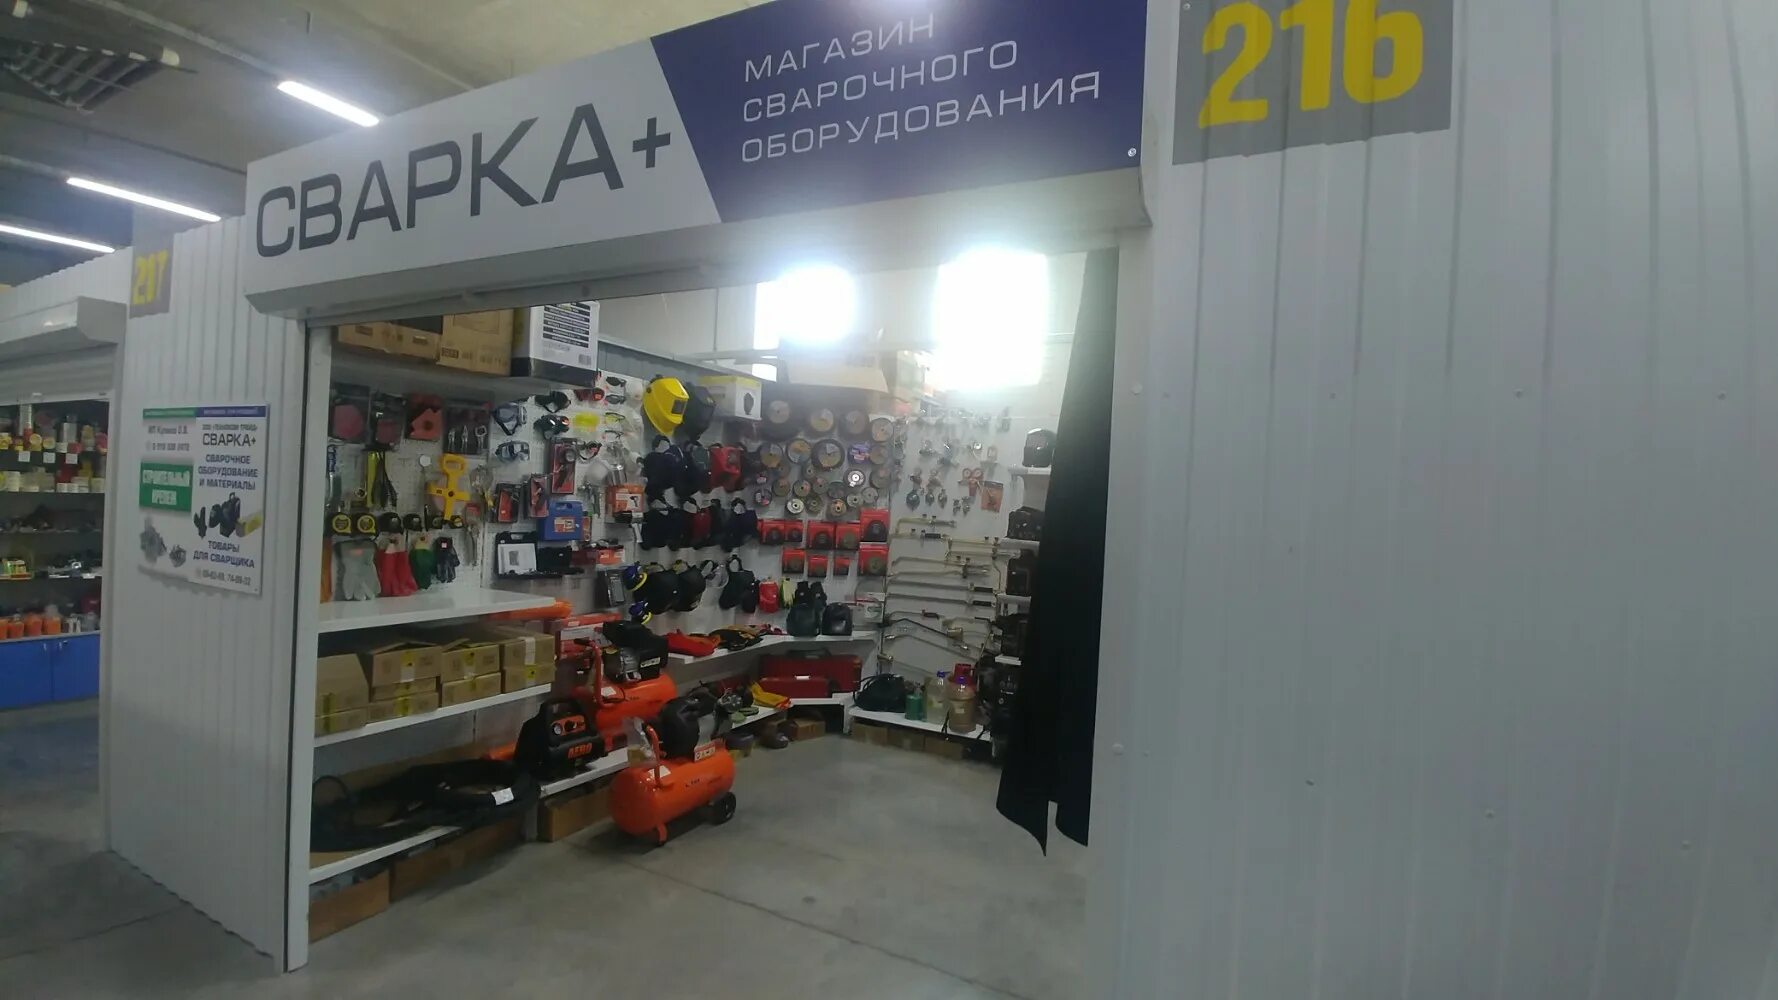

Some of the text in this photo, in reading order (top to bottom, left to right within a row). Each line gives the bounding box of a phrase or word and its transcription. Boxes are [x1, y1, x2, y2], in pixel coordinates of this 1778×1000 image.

[745, 13, 934, 82] МАГАЗИН
[1198, 0, 1424, 129] 216
[743, 40, 1017, 122] СВАРОЧНОГО
[741, 71, 1100, 162] ОБОРУДОВАНИЯ
[256, 103, 671, 258] СВАРКА+
[202, 433, 256, 447] СВАРКА+
[206, 454, 251, 464] СВАРОЧНОЕ
[198, 466, 258, 477] ОБОРУДОВАНИЕ
[199, 479, 256, 490] И МАТЕРИАЛЫ
[208, 540, 240, 553] ТОВАРЫ
[193, 550, 255, 568] ДЛЯ СВАРЩИКА
